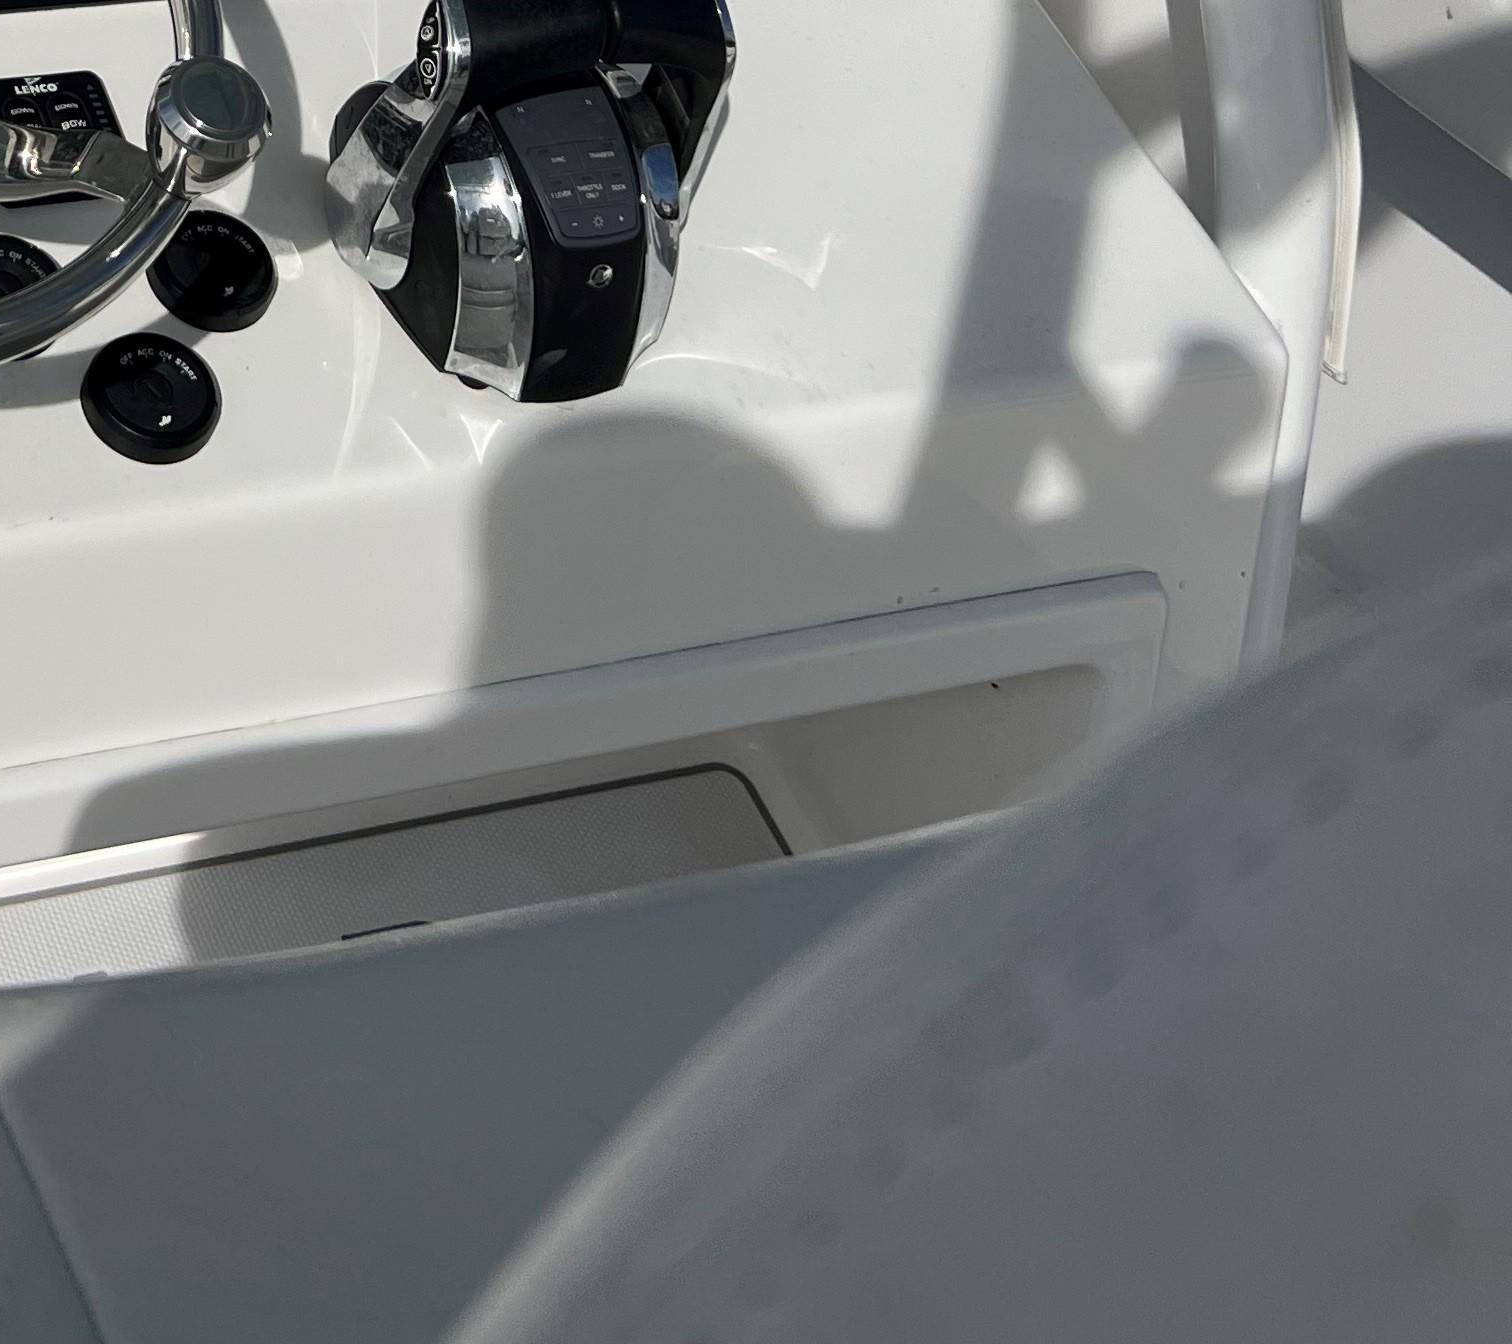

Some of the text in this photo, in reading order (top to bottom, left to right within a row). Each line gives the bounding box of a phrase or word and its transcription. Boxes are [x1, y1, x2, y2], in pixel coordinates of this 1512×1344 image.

[14, 82, 59, 96] LENCO
[60, 118, 87, 131] BOW
[175, 357, 198, 380] START
